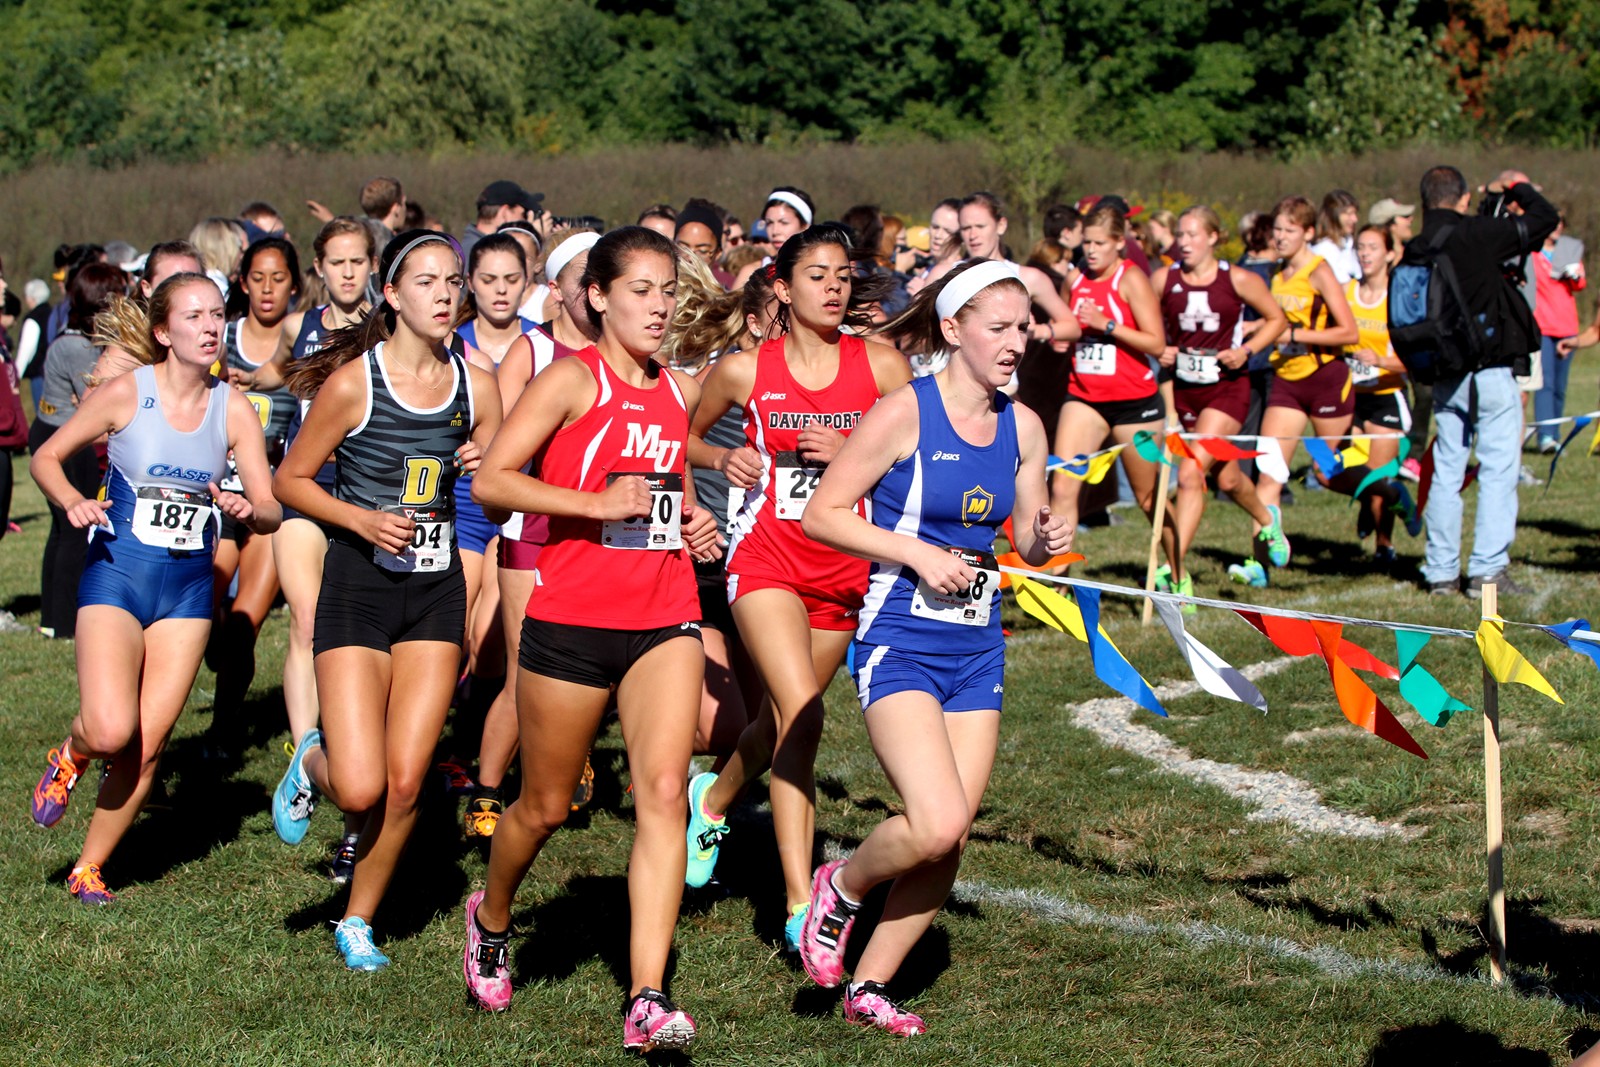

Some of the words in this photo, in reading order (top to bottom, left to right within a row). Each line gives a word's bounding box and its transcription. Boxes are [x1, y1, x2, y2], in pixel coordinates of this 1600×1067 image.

[1188, 356, 1204, 372] 31
[621, 423, 681, 473] MU
[146, 463, 213, 484] CASE
[399, 456, 445, 507] D
[790, 469, 826, 498] 24
[150, 502, 199, 531] 187
[967, 498, 987, 514] M
[411, 523, 442, 549] 04
